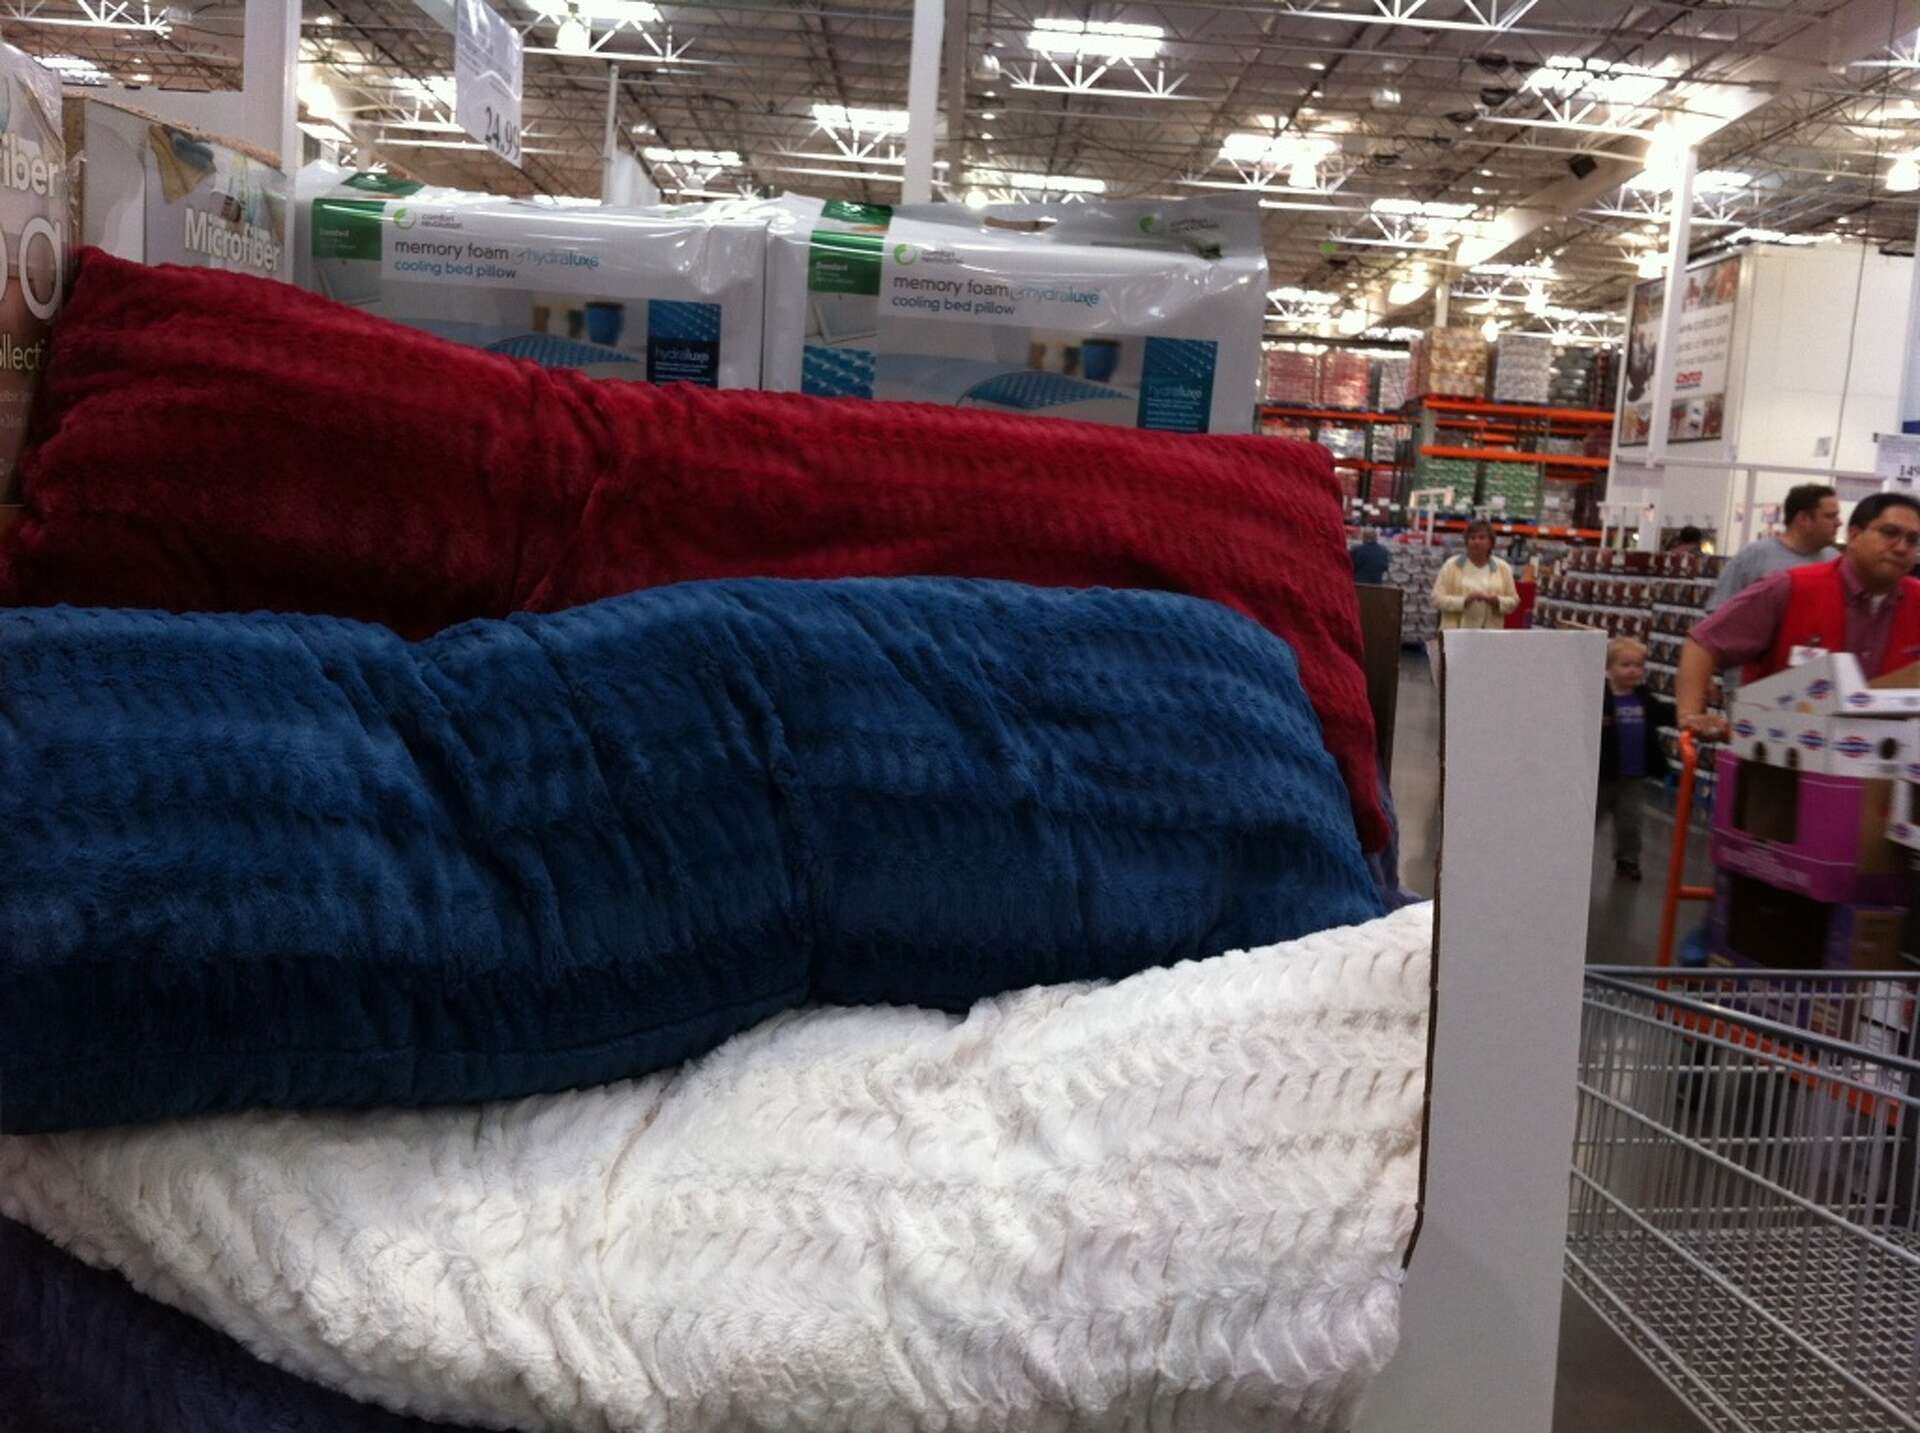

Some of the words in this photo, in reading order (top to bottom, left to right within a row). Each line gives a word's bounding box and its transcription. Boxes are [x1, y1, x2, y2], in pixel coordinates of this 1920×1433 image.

[484, 106, 520, 160] 24.99
[184, 207, 281, 271] Microfiber
[395, 240, 463, 260] memory
[467, 243, 510, 260] foam
[394, 260, 441, 277] cooling
[445, 262, 473, 276] bed
[476, 264, 516, 280] pillow
[893, 276, 963, 296] memory
[966, 280, 1010, 297] foam
[892, 295, 940, 312] cooling
[944, 298, 972, 312] bed
[974, 300, 1016, 316] pillow
